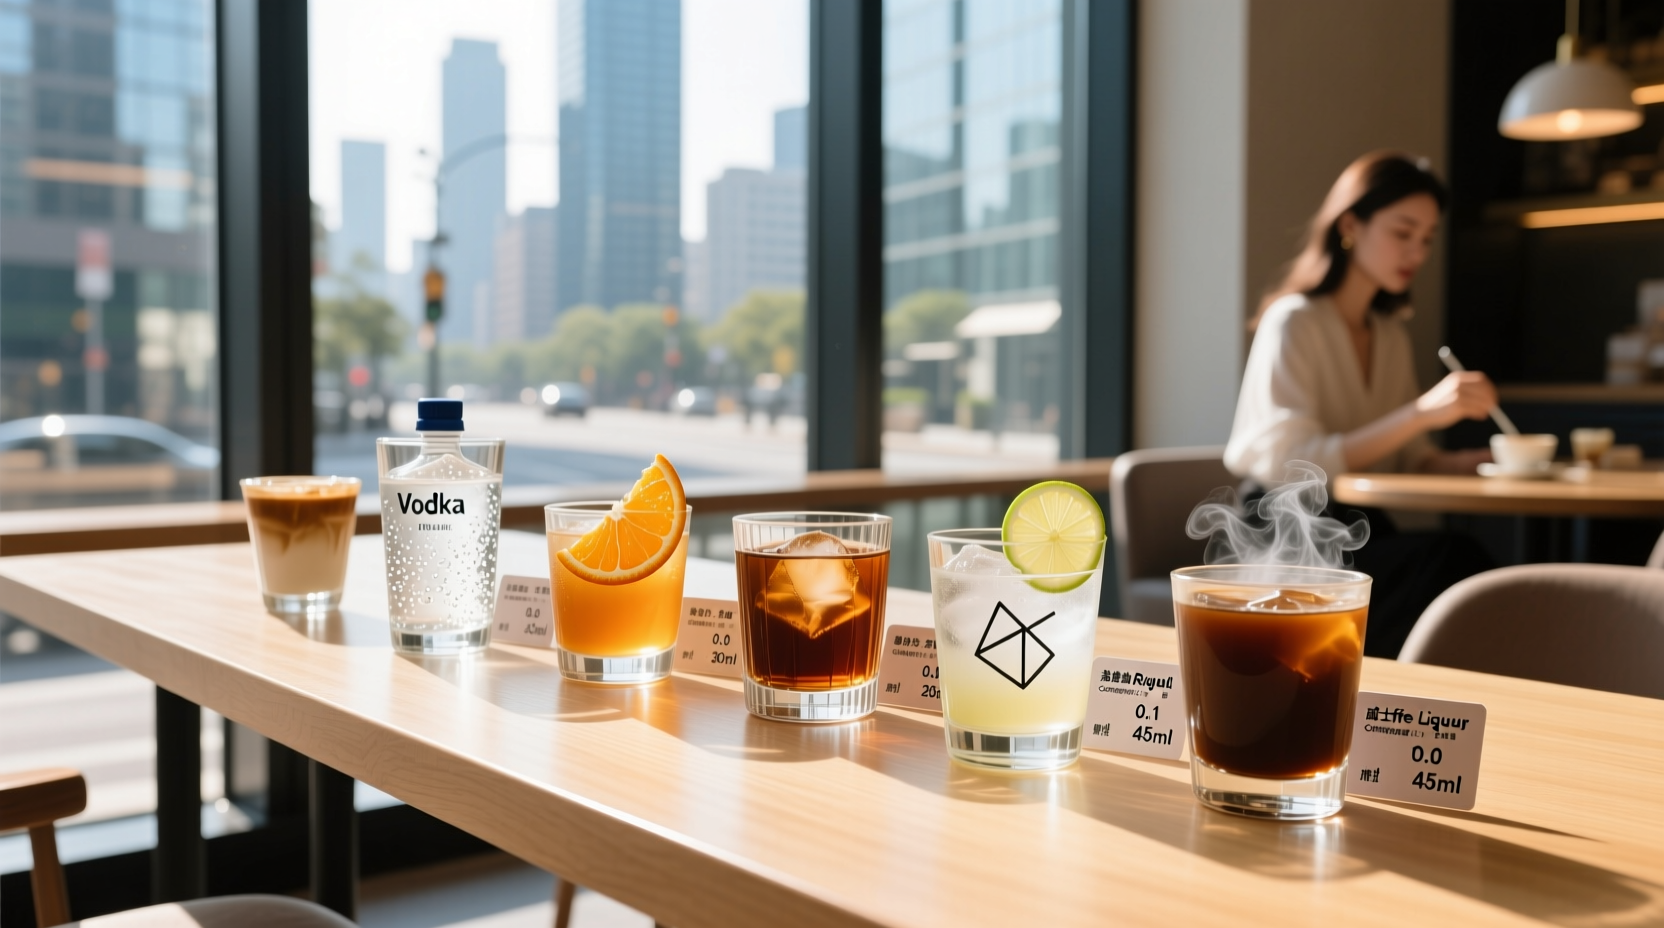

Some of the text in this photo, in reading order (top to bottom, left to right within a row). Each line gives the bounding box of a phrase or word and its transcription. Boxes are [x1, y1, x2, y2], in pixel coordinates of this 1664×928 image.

[397, 492, 465, 515] Vodka
[712, 633, 730, 646] 0.0
[1135, 704, 1159, 720] 0.1
[1132, 725, 1173, 745] 45ml
[1412, 745, 1442, 765] 0.0
[1412, 771, 1462, 794] 45ml
